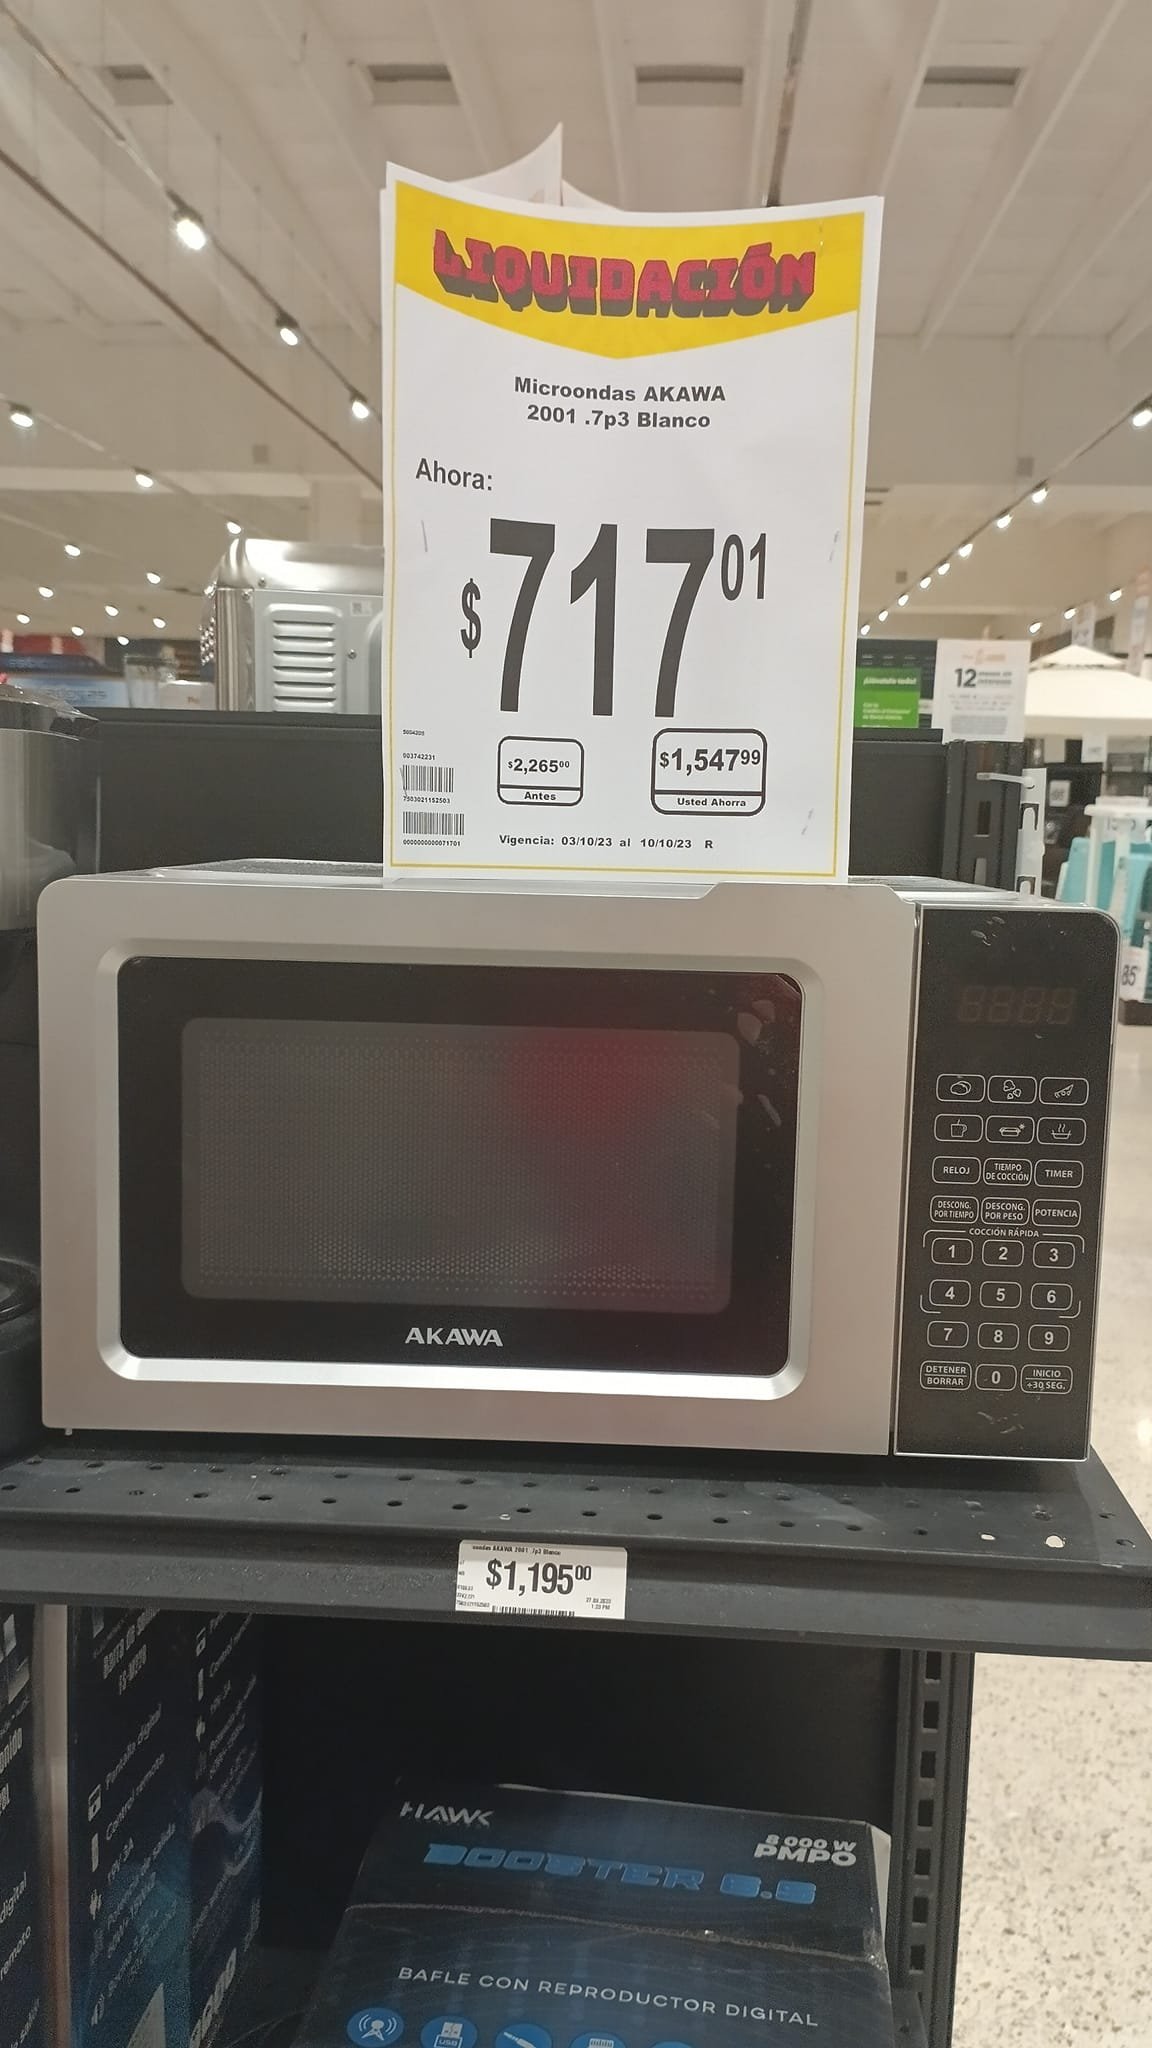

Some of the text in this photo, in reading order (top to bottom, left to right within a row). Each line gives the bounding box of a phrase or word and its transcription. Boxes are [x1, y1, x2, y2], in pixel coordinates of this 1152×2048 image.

[433, 229, 816, 317] LIQUIDACIÓN
[514, 376, 726, 402] Microondas AKAWA
[527, 404, 711, 430] 2001 .7p3 Blanco
[415, 458, 494, 491] Ahora:
[954, 668, 977, 688] 12
[524, 791, 557, 801] Antes
[677, 797, 746, 808] Usted Ahorra
[499, 835, 714, 849] Vigencia: 03/10/23 al 10/10/23 R
[943, 1166, 970, 1175] RELOJ
[994, 1163, 1022, 1172] TIEMPO
[1045, 1169, 1073, 1179] TIMER
[986, 1171, 1029, 1182] DE COCCIÓN
[938, 1200, 971, 1209] DESCONG.
[985, 1203, 1025, 1212] DESCONG.
[934, 1210, 974, 1219] POR TIEMPO
[985, 1212, 1024, 1221] POR PESO
[1035, 1209, 1078, 1218] POTENCIA
[969, 1226, 1039, 1237] COCCIÓN RÁPIDA
[948, 1245, 956, 1258] 1
[998, 1246, 1008, 1260] 2
[1049, 1248, 1059, 1262] 3
[944, 1286, 955, 1300] 4
[996, 1288, 1005, 1302] 5
[1046, 1289, 1056, 1304] 6
[405, 1327, 503, 1347] AKAWA
[943, 1328, 953, 1341] 7
[993, 1329, 1003, 1343] 8
[1044, 1331, 1054, 1345] 9
[926, 1366, 966, 1374] DETENER
[1033, 1369, 1061, 1378] INICIO
[927, 1377, 964, 1386] BORRAR
[991, 1371, 1001, 1385] 0
[1026, 1381, 1066, 1390] +30 SEG.
[0, 1728, 22, 1774] onido
[400, 1801, 494, 1827] HAWK
[833, 1840, 857, 1851] W
[754, 1843, 857, 1867] PMPO
[0, 1925, 31, 1981] remoto
[398, 1967, 819, 2027] BAFLE CON REPRODUCTOR DIGITAL
[438, 2039, 458, 2047] USB
